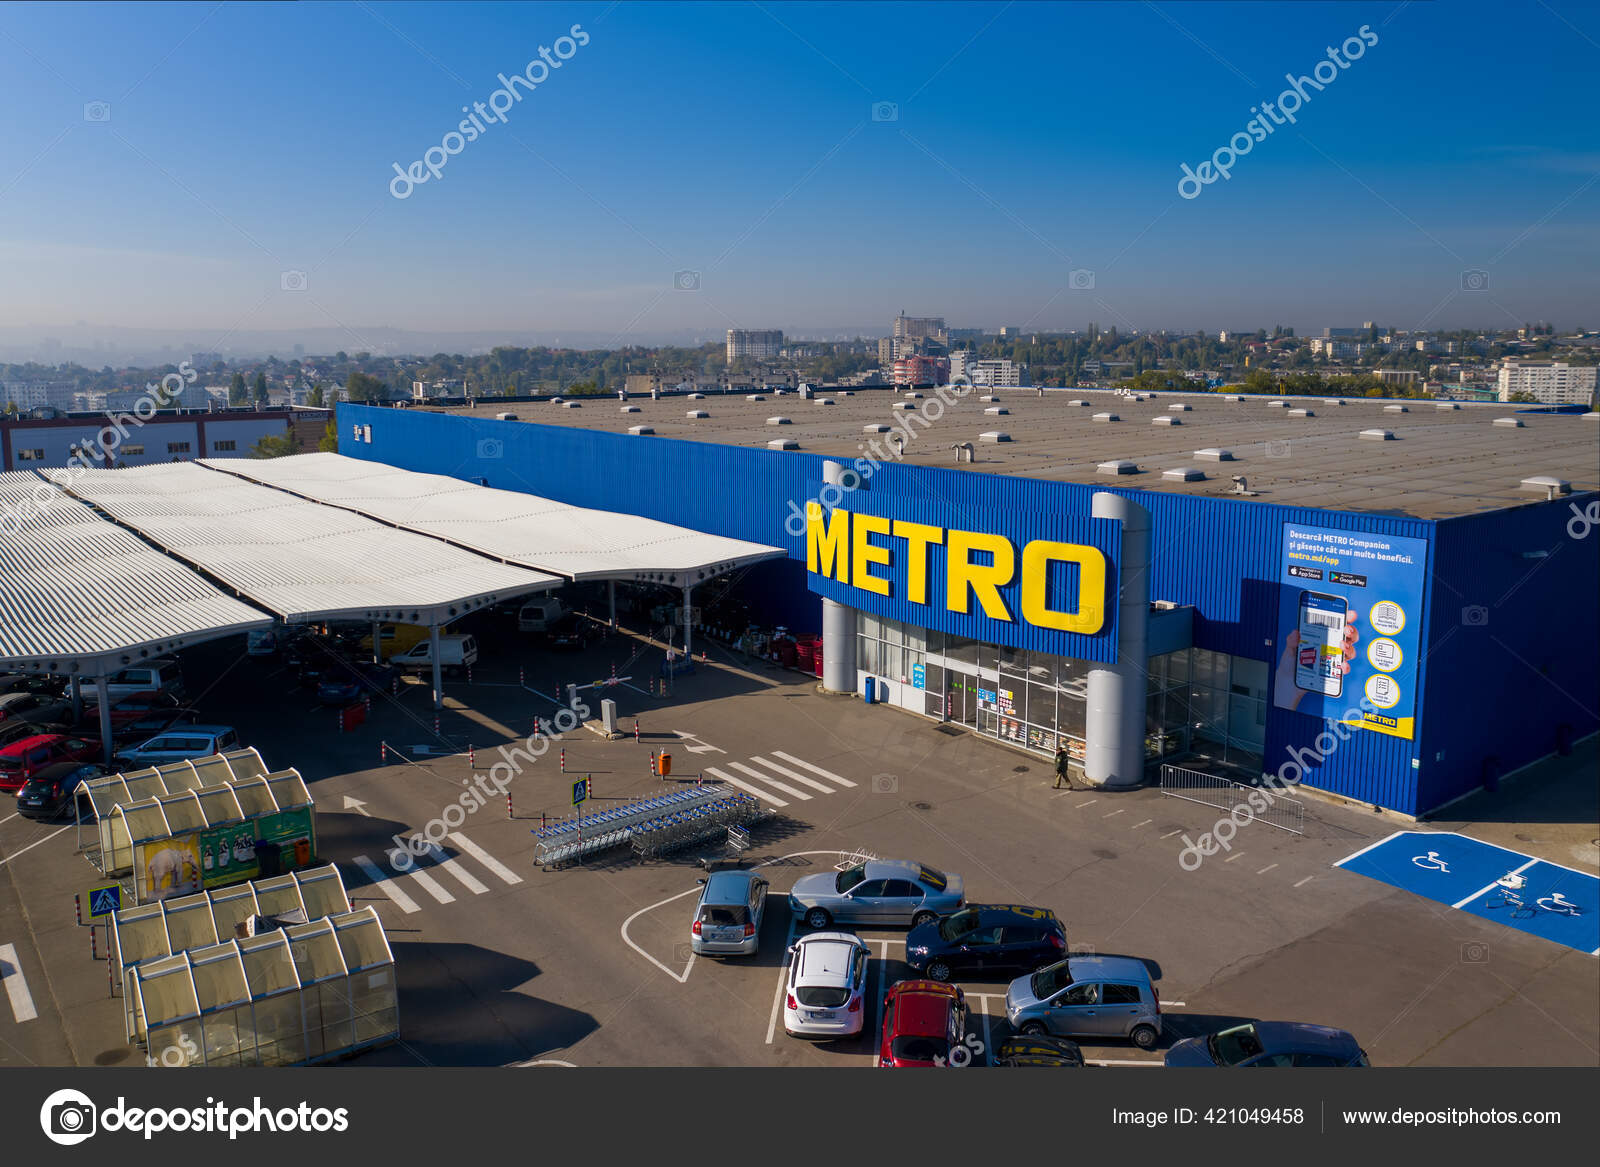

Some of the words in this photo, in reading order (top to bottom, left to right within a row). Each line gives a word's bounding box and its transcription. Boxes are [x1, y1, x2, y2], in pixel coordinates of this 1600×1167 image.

[1289, 530, 1322, 541] Descarcă
[1323, 535, 1348, 545] METRO
[1349, 538, 1390, 550] Companion
[1288, 552, 1339, 566] metro.md/app
[1339, 548, 1352, 556] mai
[1354, 550, 1376, 560] multe
[1377, 552, 1413, 564] beneficii.
[807, 501, 1106, 635] METRO
[1363, 712, 1396, 727] METRO
